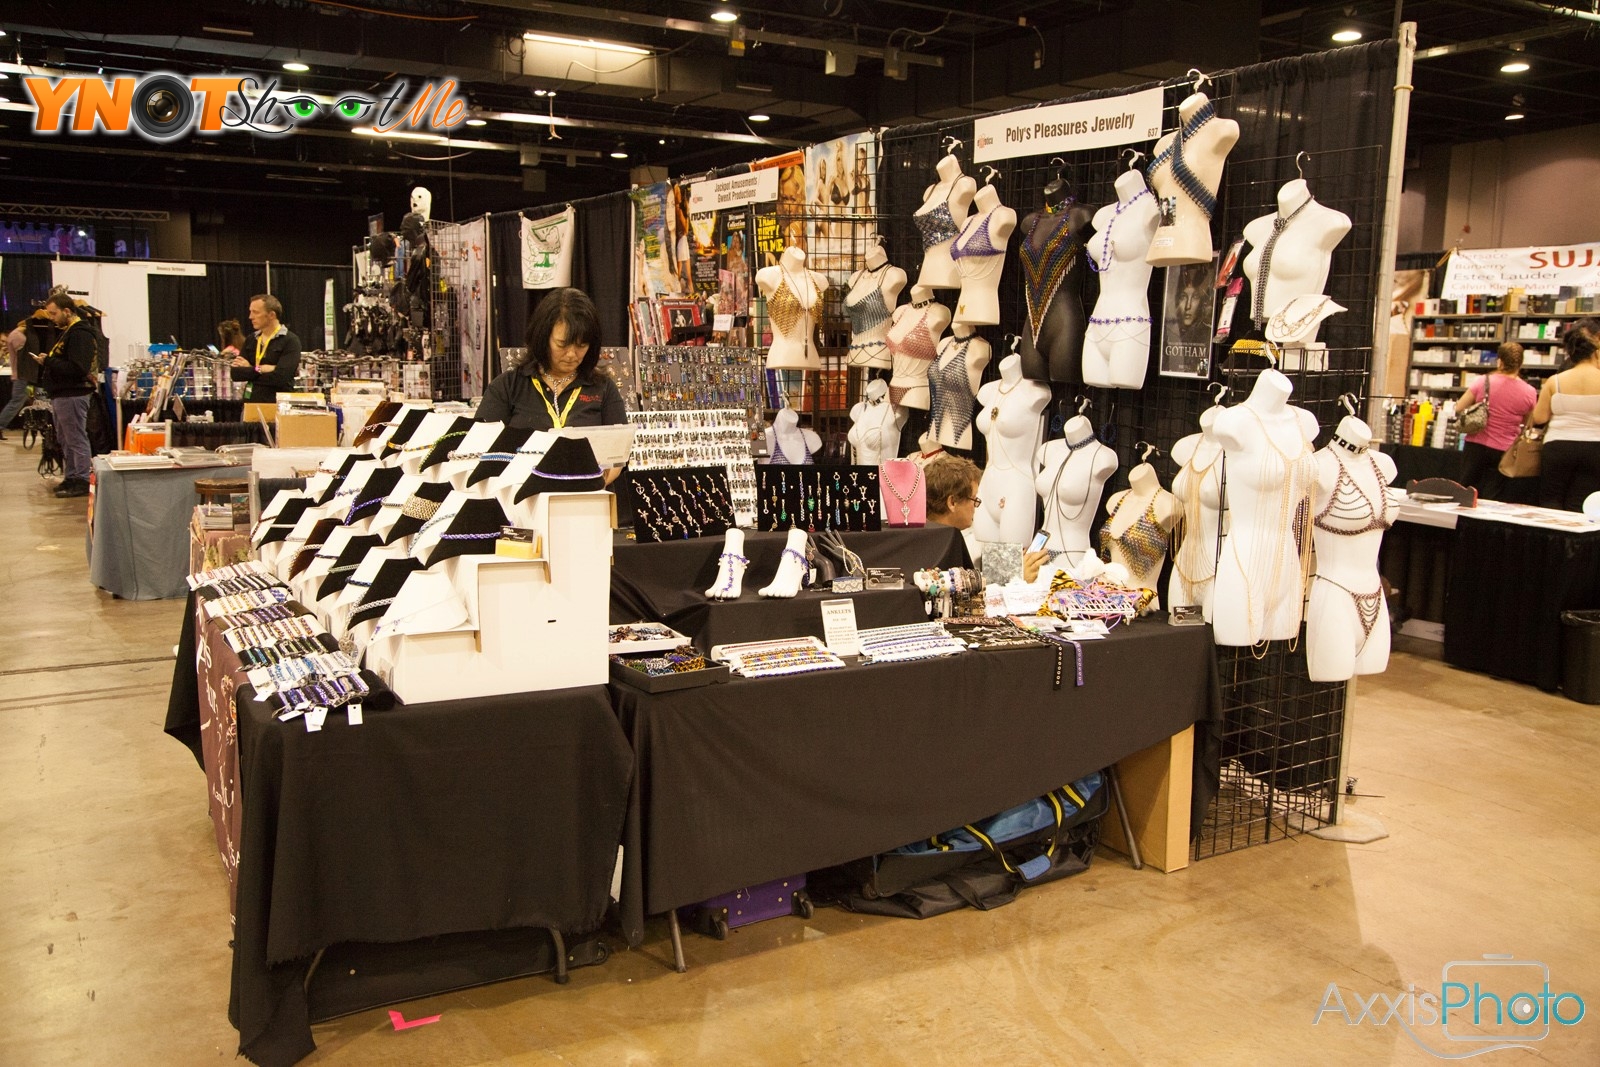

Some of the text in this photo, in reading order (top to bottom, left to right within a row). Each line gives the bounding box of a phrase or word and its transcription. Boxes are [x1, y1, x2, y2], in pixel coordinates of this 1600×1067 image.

[1006, 125, 1031, 143] Poly's
[1034, 120, 1088, 139] Pleasures
[1092, 112, 1135, 132] Jewelry
[1147, 128, 1158, 137] 637
[714, 176, 757, 192] Jackpot Amusements
[731, 188, 756, 201] Productions
[1453, 271, 1559, 281] Estee Lauder
[1451, 282, 1486, 290] Calvin
[1165, 345, 1207, 357] GOTHAM
